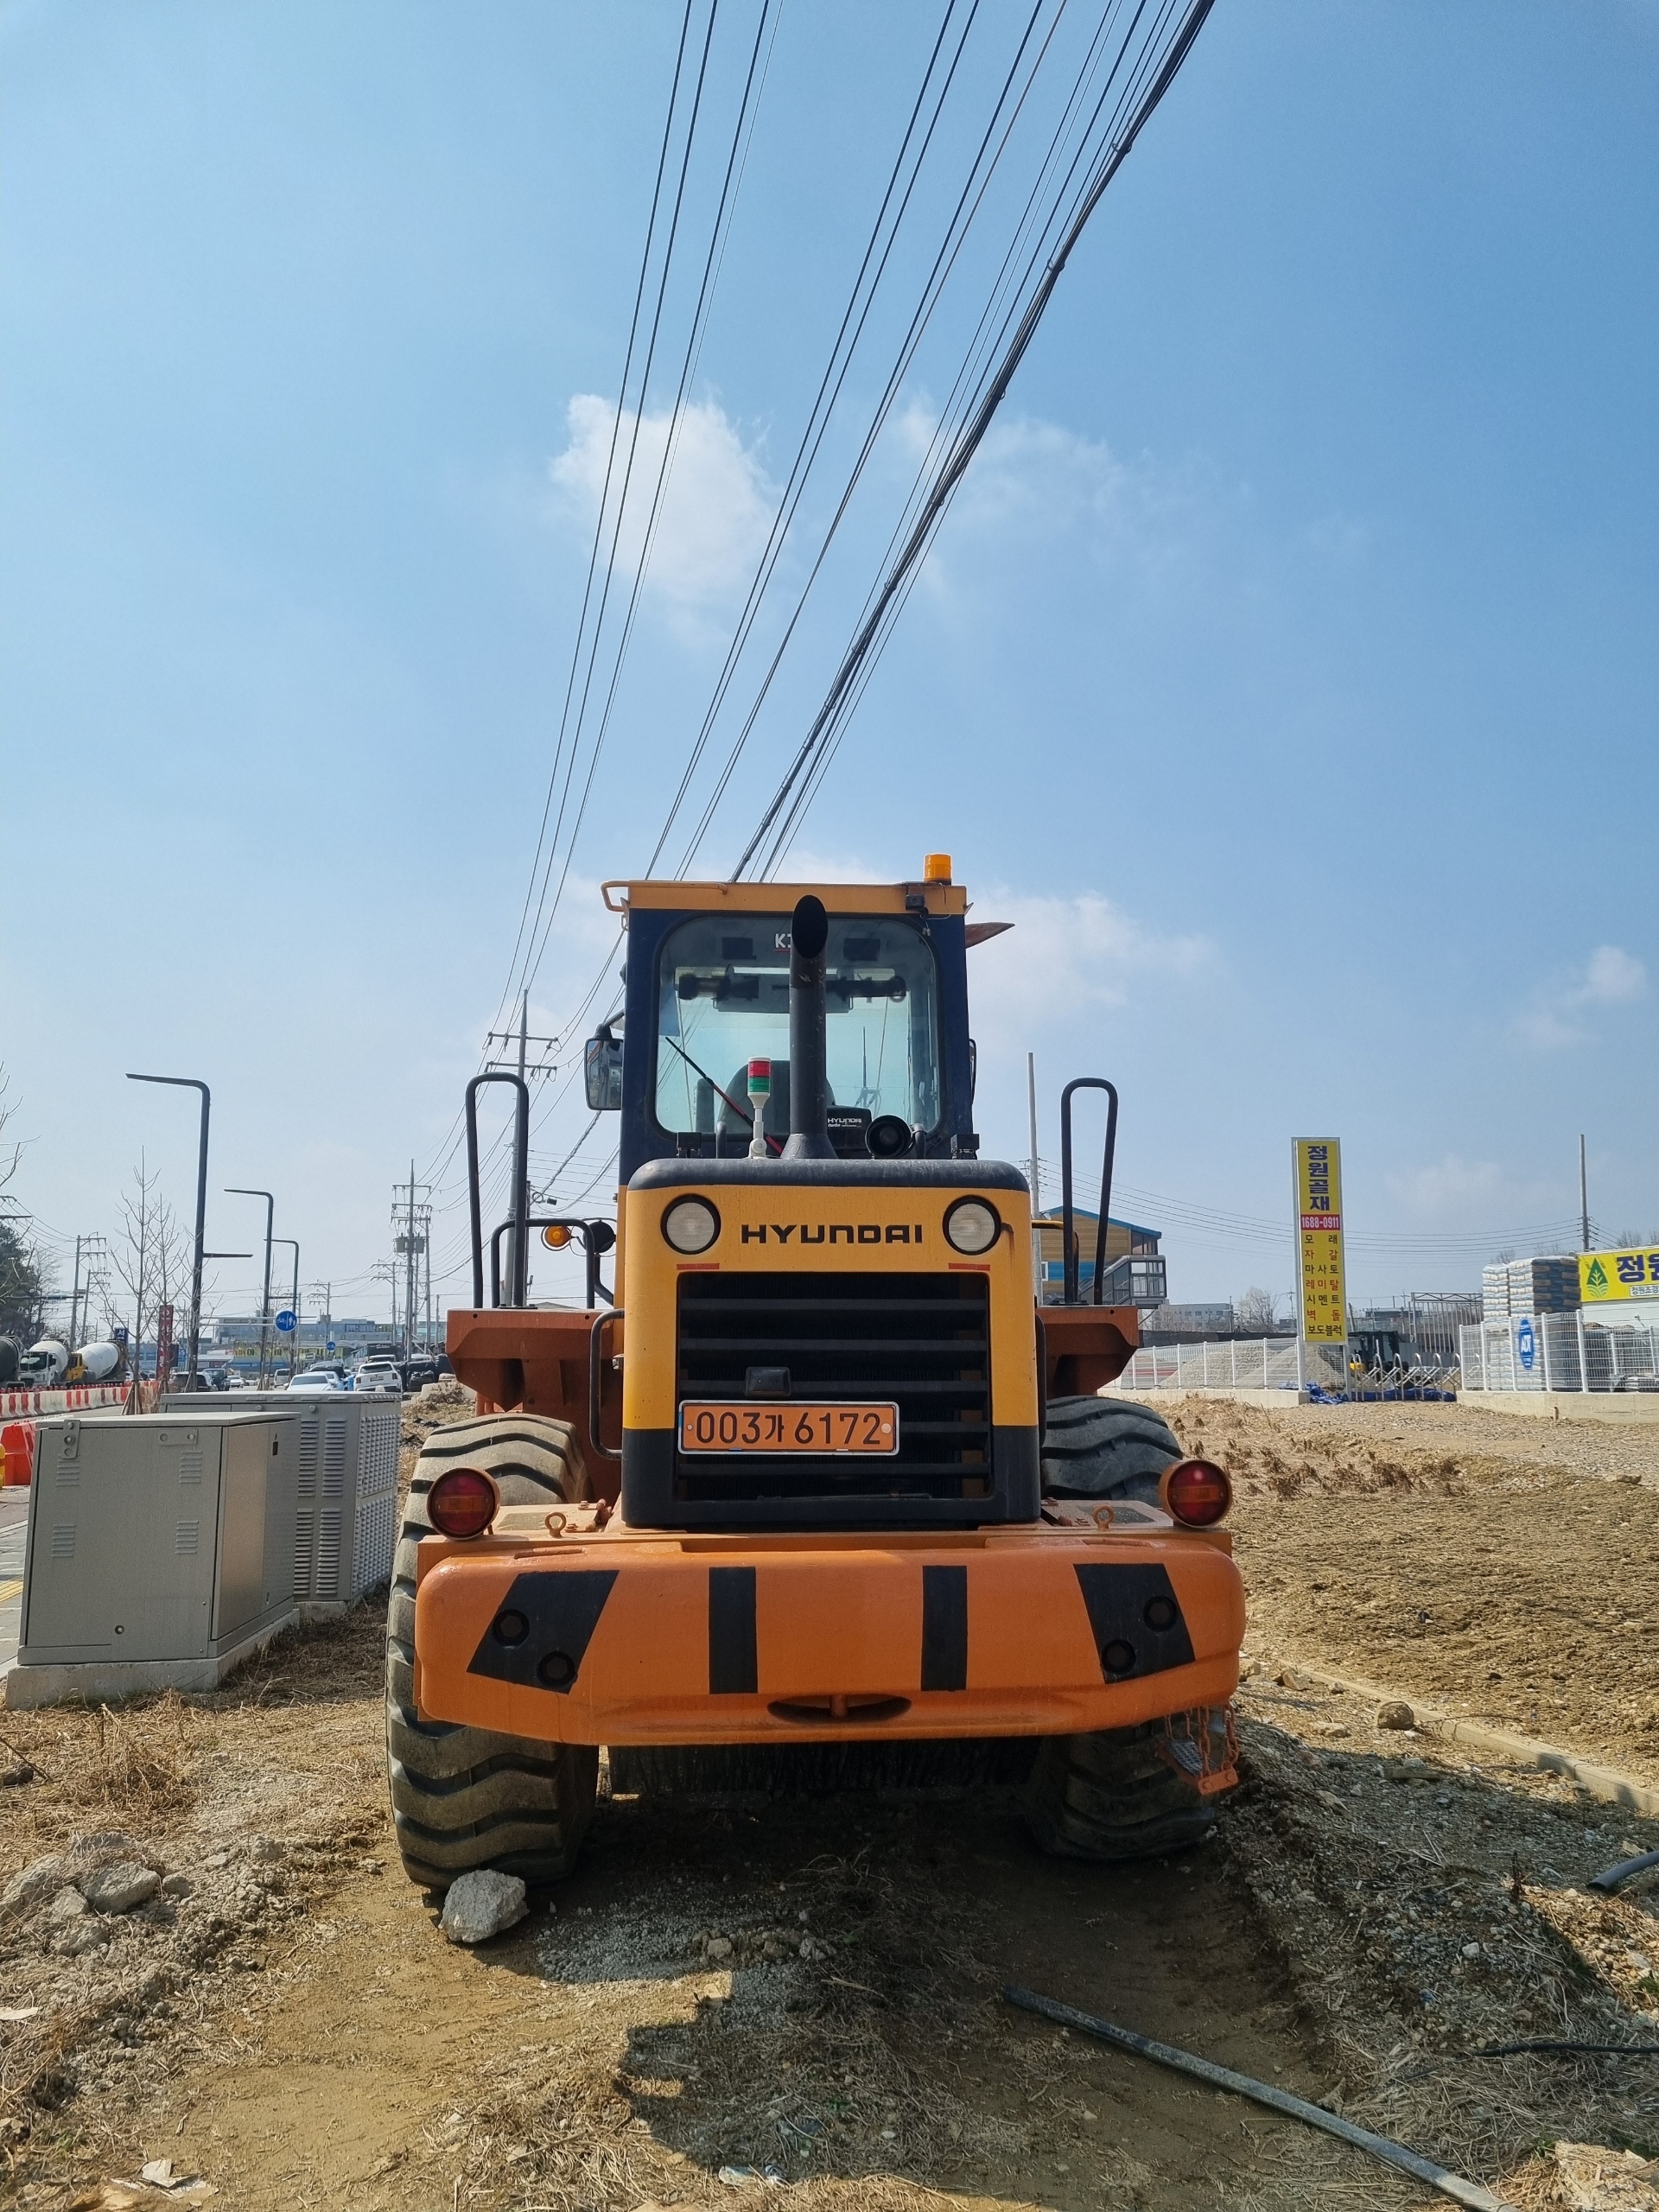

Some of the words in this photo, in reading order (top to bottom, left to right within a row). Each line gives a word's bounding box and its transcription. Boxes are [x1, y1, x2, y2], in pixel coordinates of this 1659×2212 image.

[1307, 1146, 1330, 1211] 정원골재
[1301, 1217, 1339, 1229] 1688-0911
[741, 1224, 923, 1244] HYUNDAI
[1307, 1325, 1343, 1337] 보도블럭
[1521, 1334, 1531, 1353] ADT
